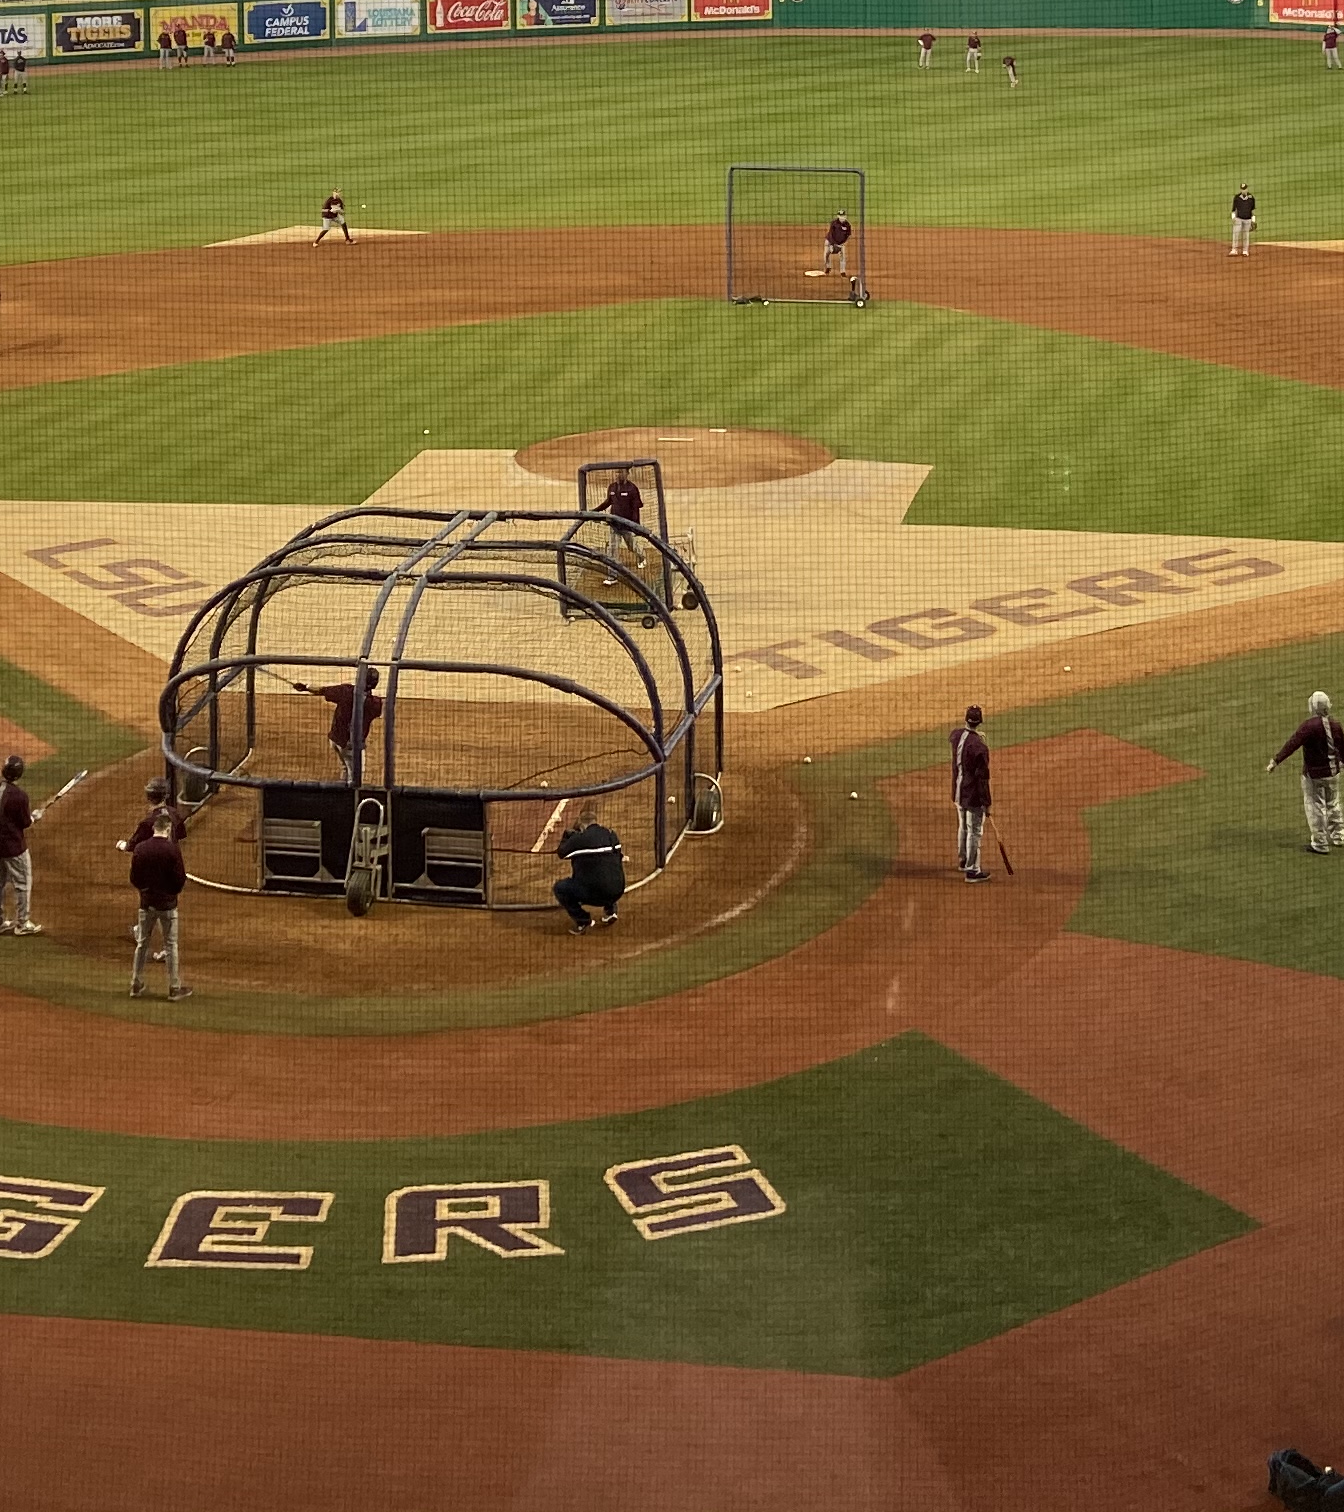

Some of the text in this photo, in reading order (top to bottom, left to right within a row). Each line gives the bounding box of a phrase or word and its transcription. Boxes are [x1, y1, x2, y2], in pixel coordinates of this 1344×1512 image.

[704, 5, 760, 15] McDonald's
[1282, 7, 1344, 19] McDonald's
[76, 15, 122, 28] MORE
[265, 16, 309, 27] CAMPUS
[67, 25, 132, 41] TIGERS
[265, 27, 310, 37] FEDERAL
[24, 538, 211, 617] LSU
[722, 548, 1286, 680] TIGERS
